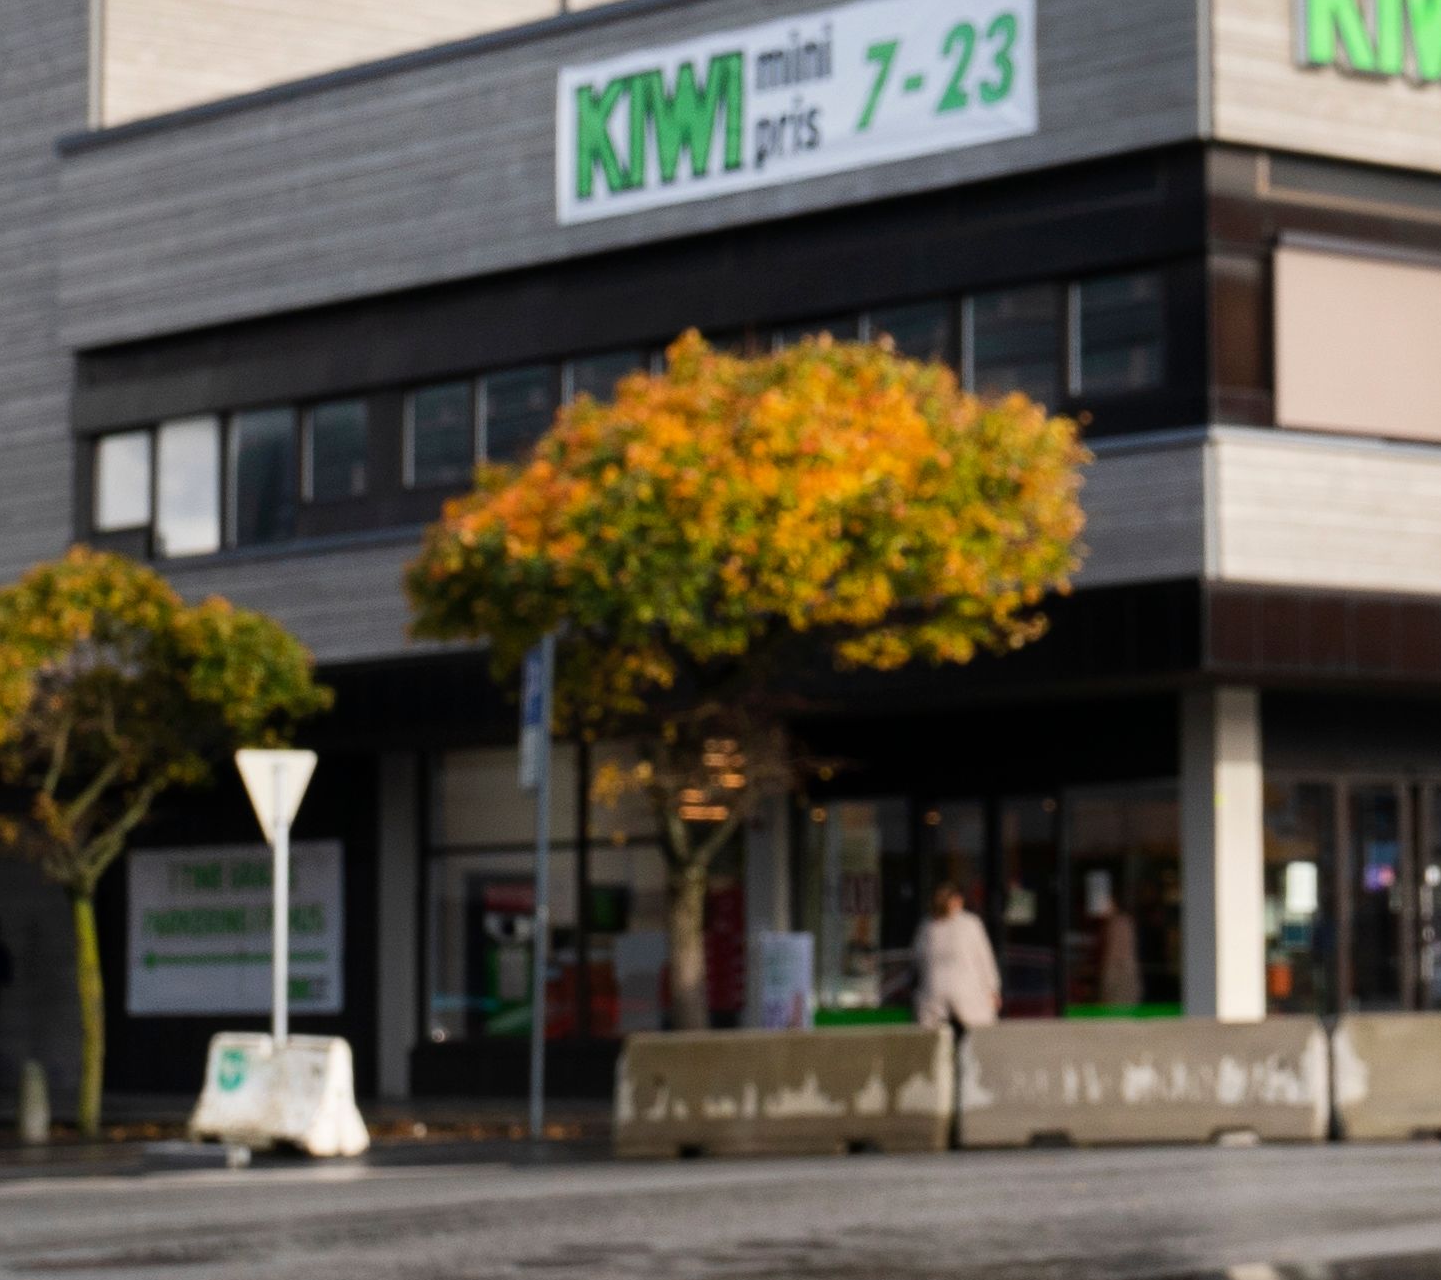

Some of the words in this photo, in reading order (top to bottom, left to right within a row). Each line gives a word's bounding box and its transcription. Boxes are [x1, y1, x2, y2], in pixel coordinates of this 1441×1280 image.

[756, 20, 832, 90] mini
[575, 51, 743, 200] KIWI
[756, 97, 821, 168] pris
